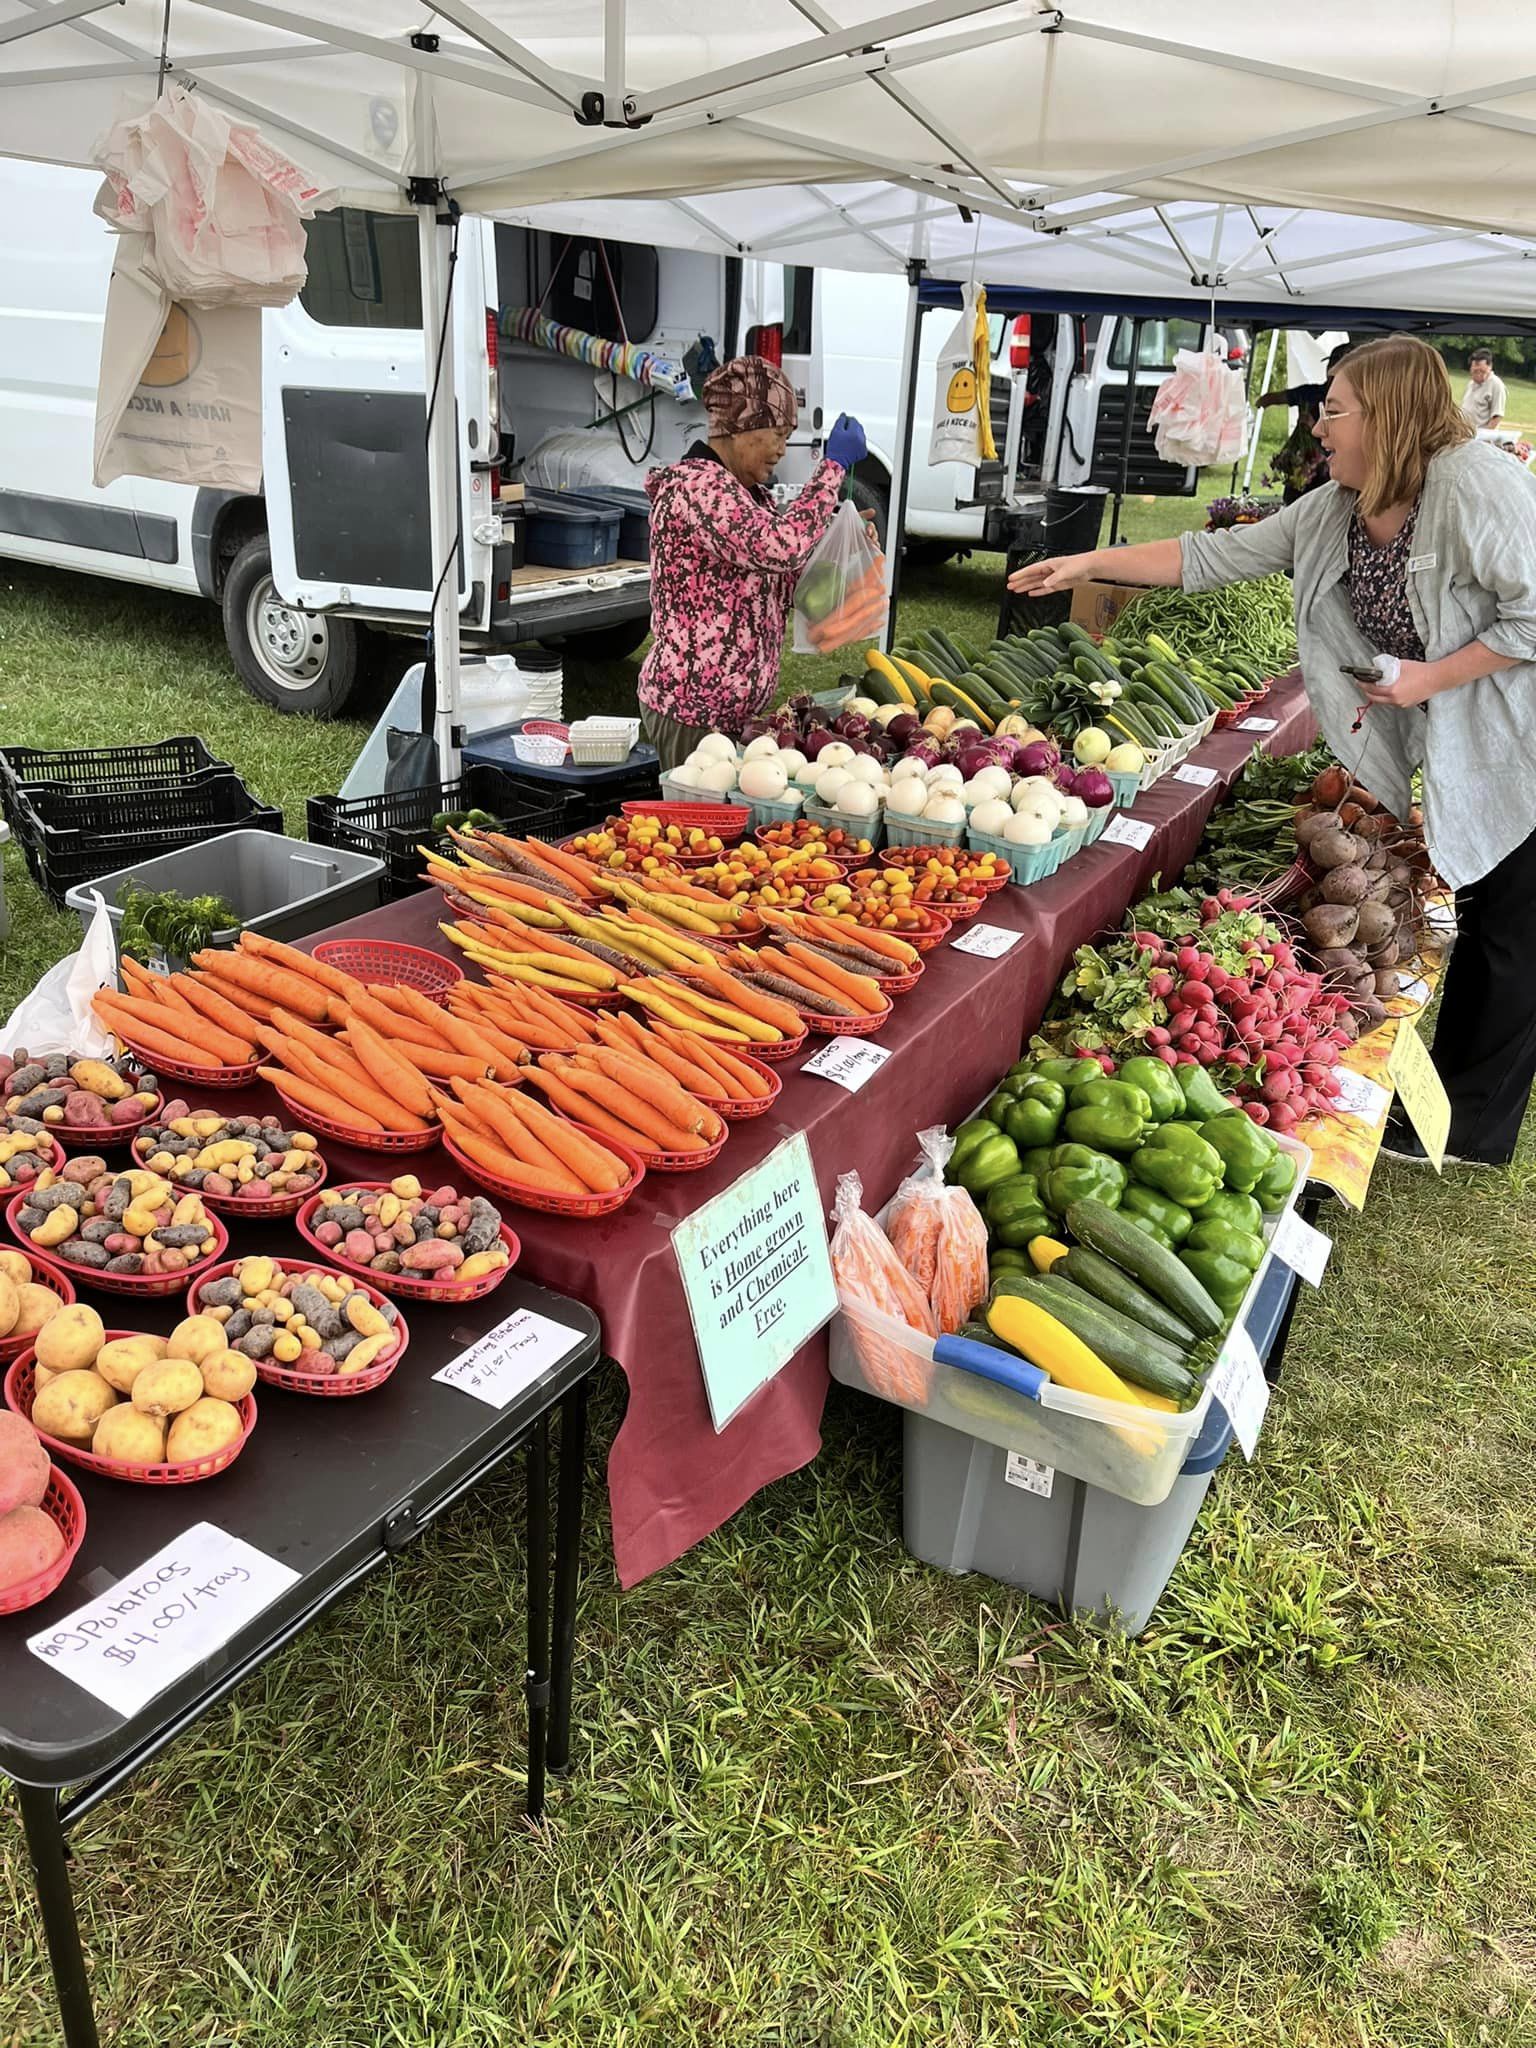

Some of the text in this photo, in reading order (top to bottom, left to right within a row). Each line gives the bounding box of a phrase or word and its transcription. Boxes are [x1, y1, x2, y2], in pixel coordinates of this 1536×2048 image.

[700, 1179, 801, 1270] Everything here
[710, 1211, 804, 1299] is Home grown
[719, 1240, 808, 1329] and Chemical-
[754, 1297, 787, 1333] Free.
[76, 1561, 191, 1639] Potatoes
